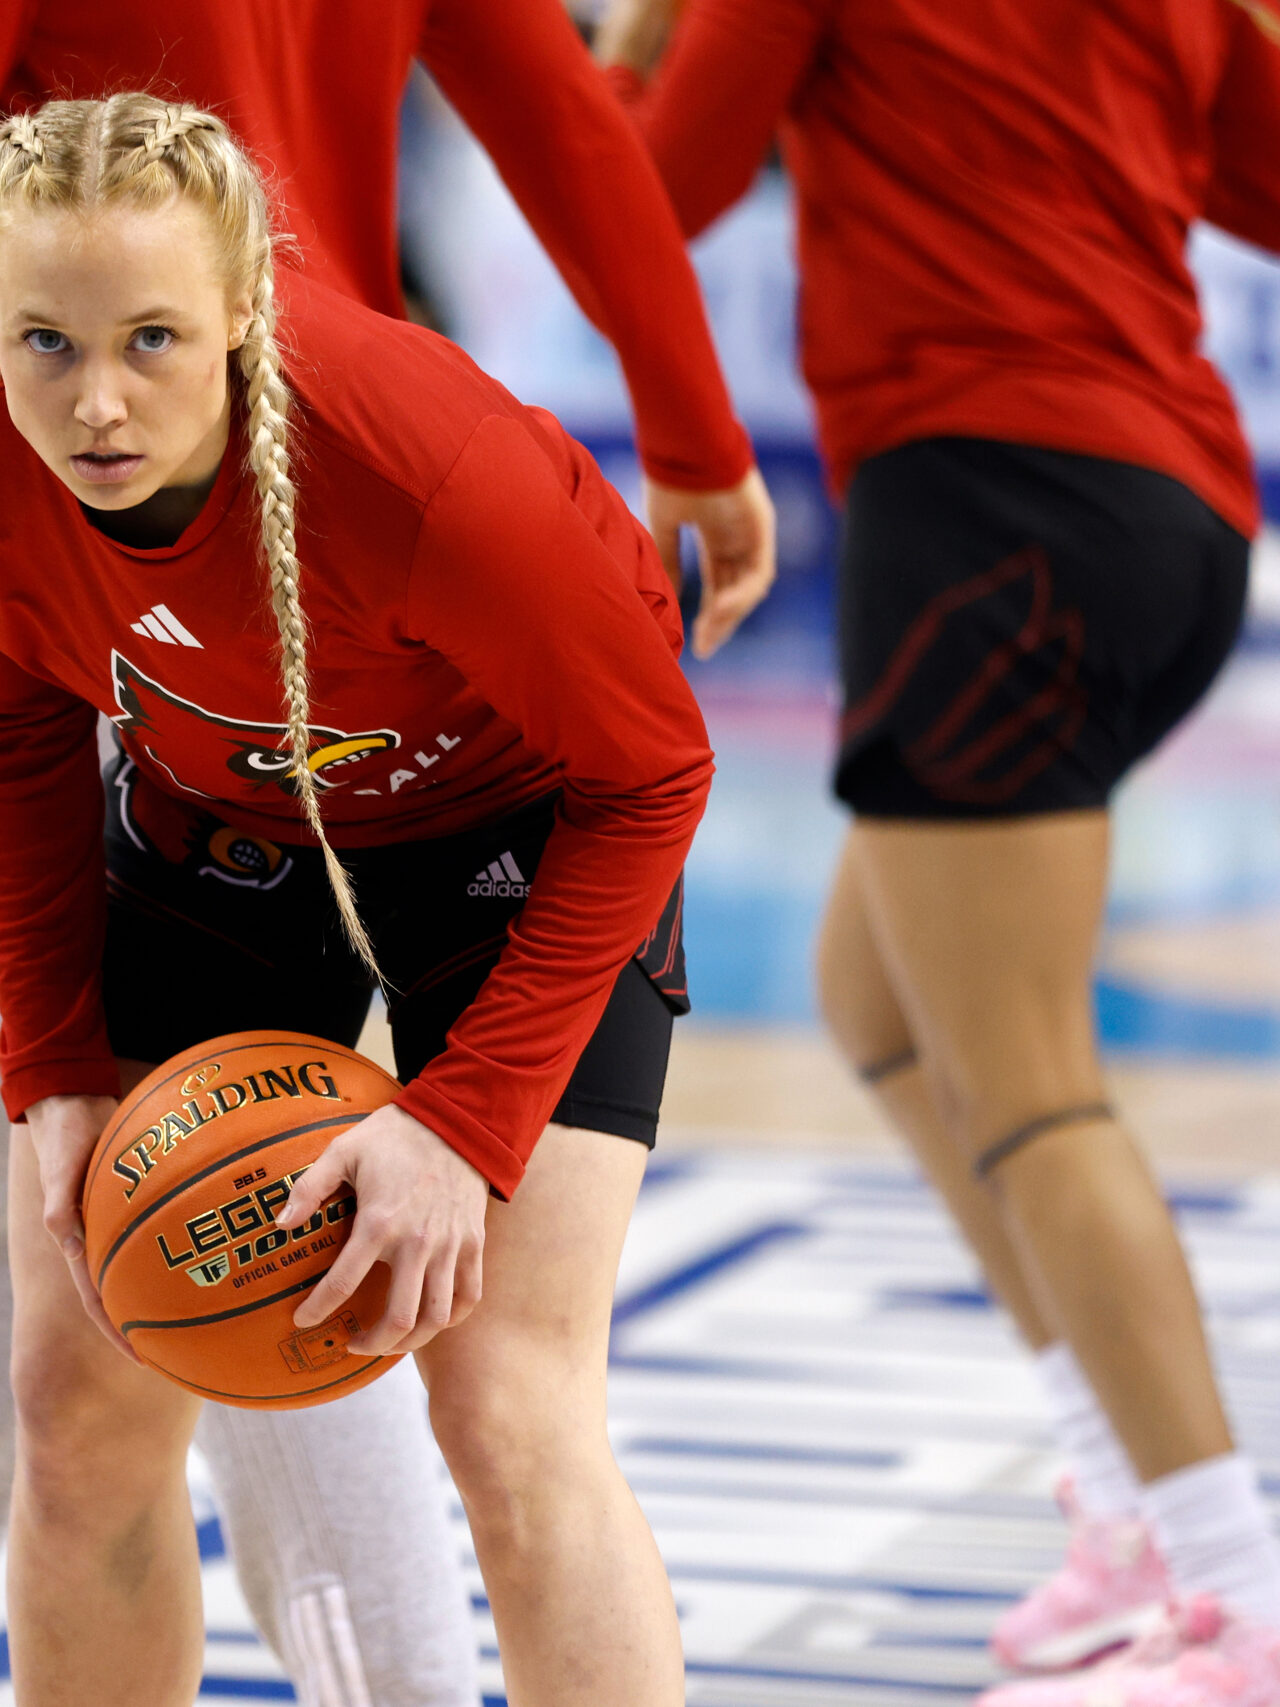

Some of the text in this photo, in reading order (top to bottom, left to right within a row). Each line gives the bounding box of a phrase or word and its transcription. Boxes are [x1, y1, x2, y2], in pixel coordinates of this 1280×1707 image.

[353, 733, 462, 796] ALL
[467, 880, 532, 898] adidas
[112, 1061, 342, 1203] SPALDING
[233, 1167, 268, 1191] 28.5
[232, 1235, 337, 1290] OFFICIAL GAME BALL
